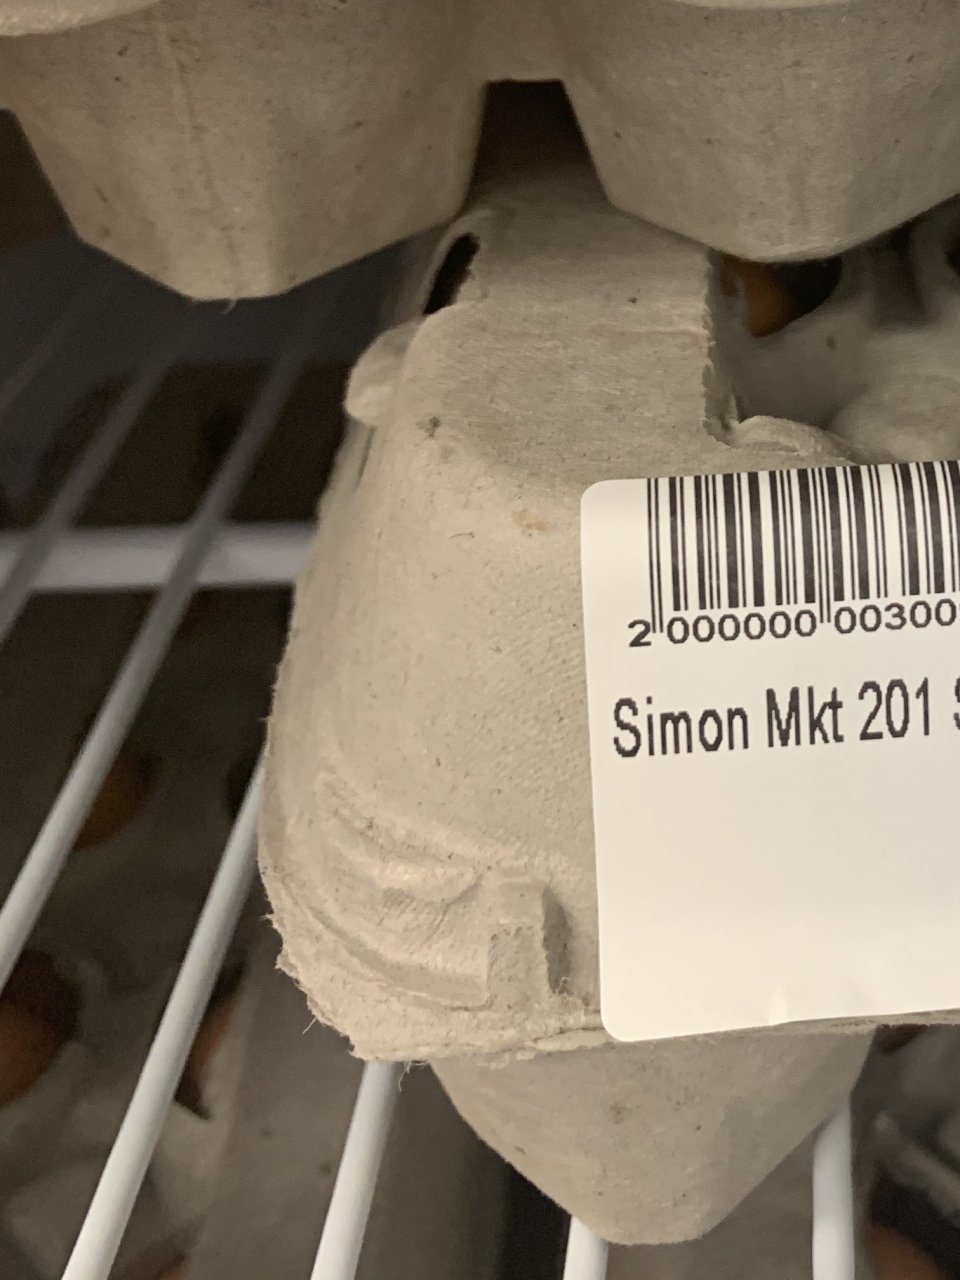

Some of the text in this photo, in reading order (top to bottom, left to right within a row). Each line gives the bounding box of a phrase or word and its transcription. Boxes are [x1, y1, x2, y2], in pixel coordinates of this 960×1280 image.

[613, 695, 749, 758] Simon
[765, 685, 845, 748] Mkt
[857, 676, 931, 741] 201
